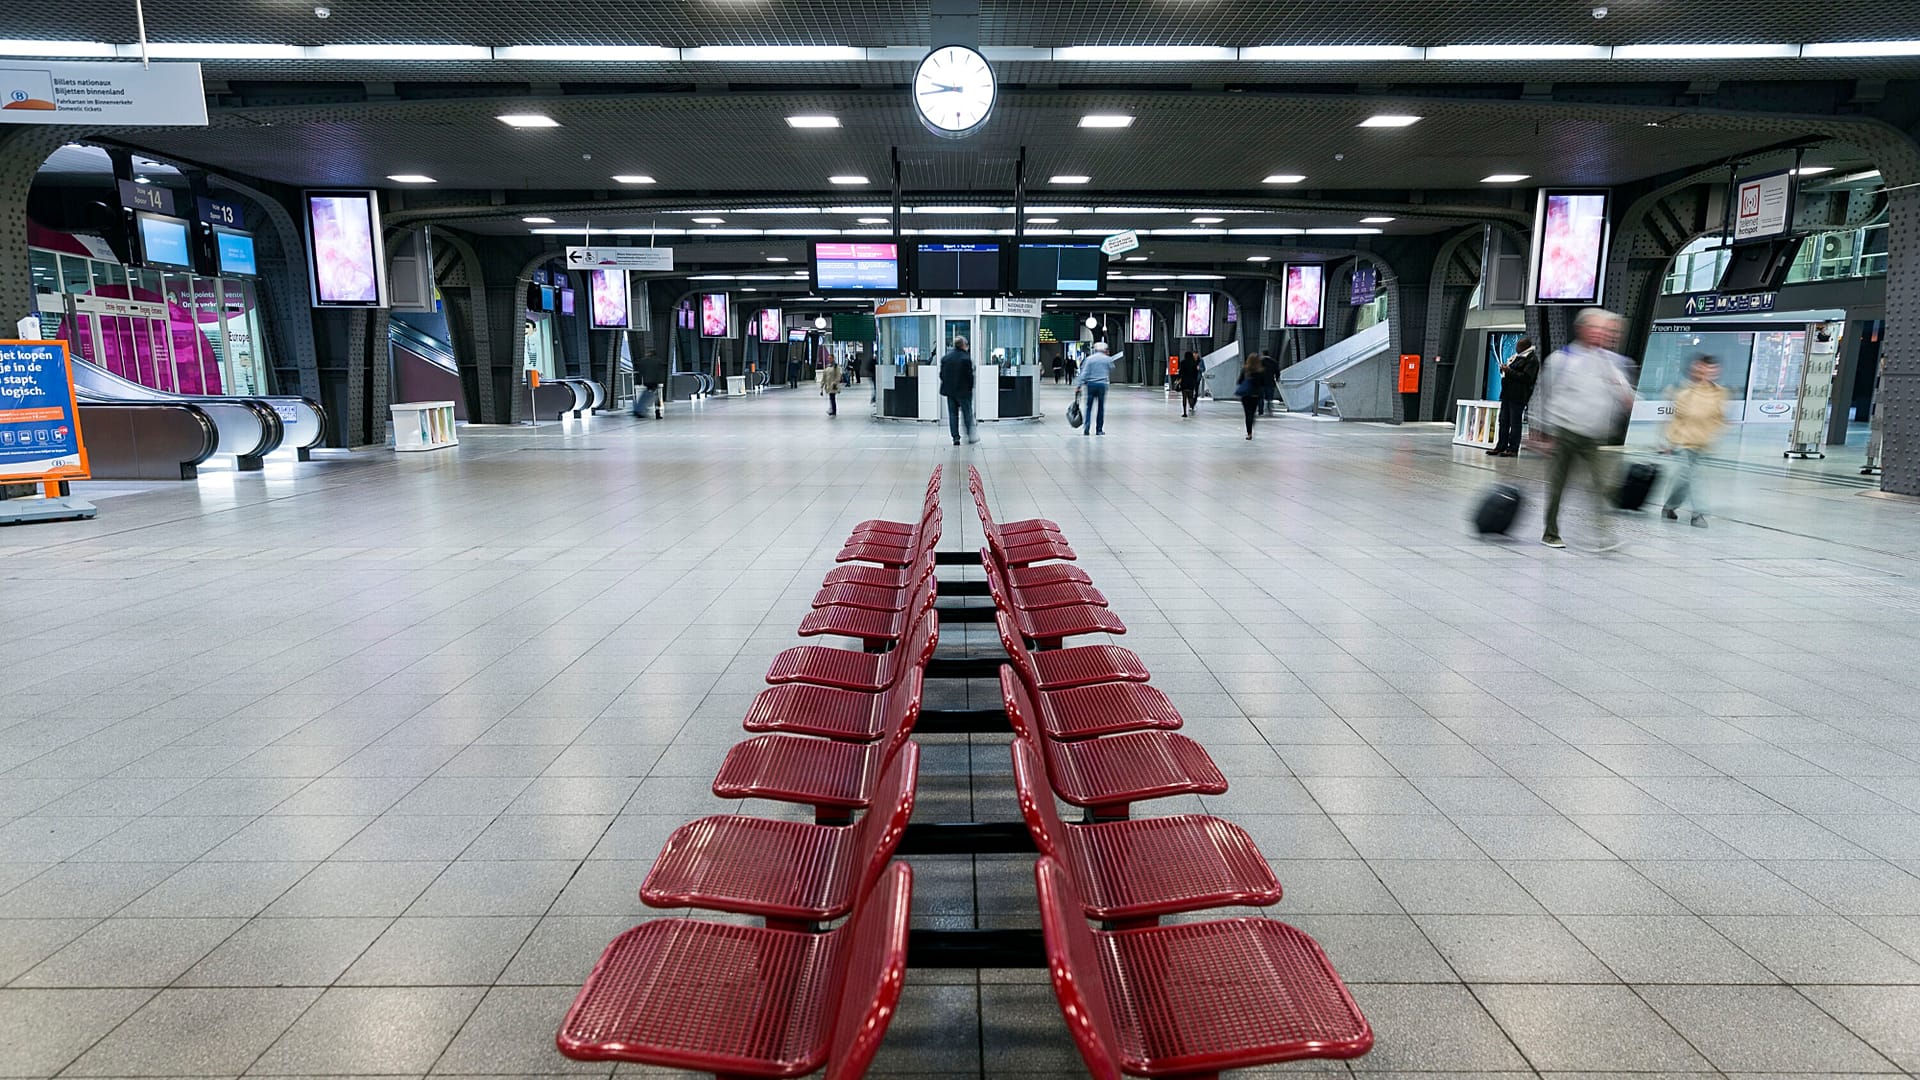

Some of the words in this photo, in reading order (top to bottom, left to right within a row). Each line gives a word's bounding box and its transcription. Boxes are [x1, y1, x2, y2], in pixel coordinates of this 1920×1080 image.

[53, 78, 76, 86] Billets
[55, 87, 86, 96] Biljetten
[86, 88, 125, 96] binnenland
[147, 189, 162, 209] 14
[221, 205, 233, 223] 13
[17, 350, 53, 362] kopen
[13, 362, 26, 372] in
[28, 362, 42, 372] de
[3, 375, 37, 387] stapt,
[1, 386, 46, 398] logisch.
